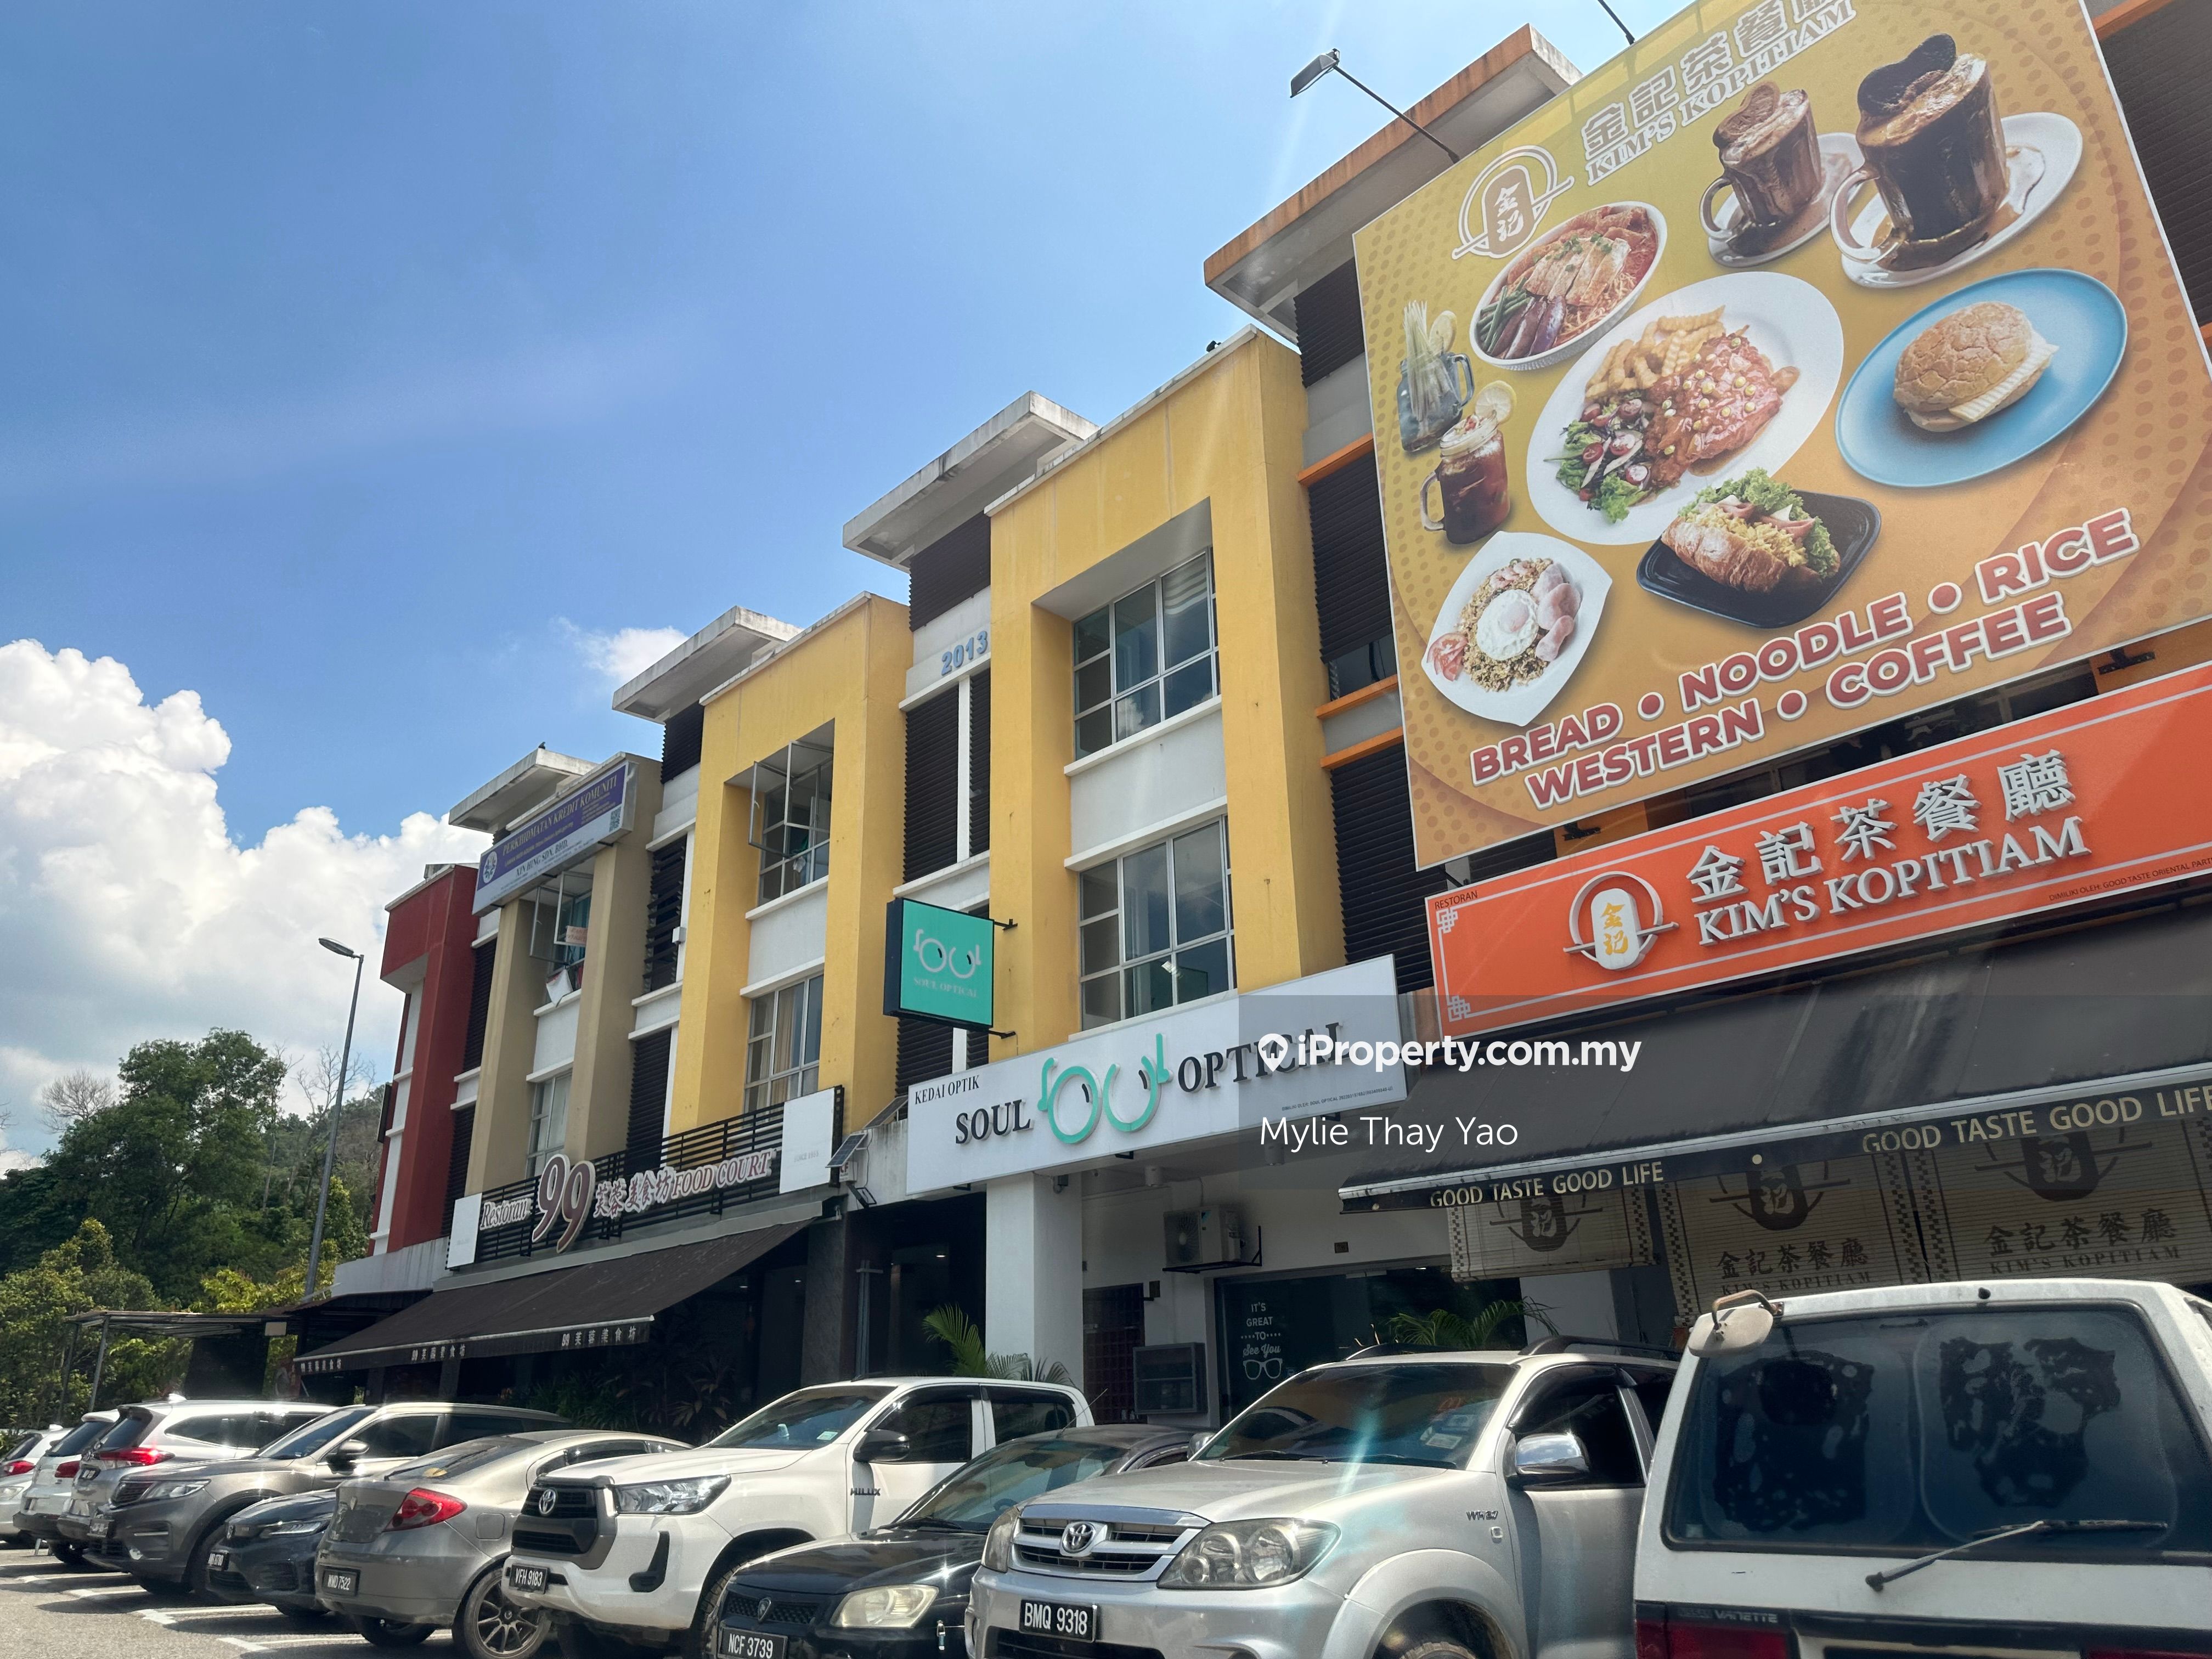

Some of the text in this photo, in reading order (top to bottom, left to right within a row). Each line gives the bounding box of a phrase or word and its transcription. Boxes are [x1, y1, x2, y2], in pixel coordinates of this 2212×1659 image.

[1587, 0, 1853, 183] KIM'S KOPITIAM
[941, 631, 988, 676] 2013
[1472, 509, 2138, 783] BREAD NOODLE RICE
[1527, 592, 2070, 808] WESTERN COFFEE
[1686, 749, 2075, 904] 金記茶餐廳
[1694, 815, 2091, 946] KIM'S KOPITIAM
[2049, 857, 2212, 901] DIMILIKI OLEH: GOOD TASTE ORIENTAL PART
[1435, 890, 1478, 910] RESTORAN
[915, 1075, 980, 1105] KEDAI OPTIK
[956, 1099, 1032, 1144] SOUL
[1178, 1022, 1351, 1093] OPTICAL
[1862, 1085, 2212, 1153] GOOD TASTE GOOD LIFE
[1430, 1161, 1664, 1207] GOOD TASTE GOOD LIFE
[480, 1200, 530, 1229] Restoran
[532, 1154, 596, 1254] 99
[672, 1166, 714, 1199] FOOD
[716, 1149, 773, 1188] COURT
[2062, 1245, 2181, 1268] KOPITIAM
[1778, 1271, 1871, 1290] KOPITIAM
[1246, 1317, 1273, 1327] GREAT
[1251, 1302, 1266, 1313] IT'S
[1243, 1344, 1282, 1358] See You
[850, 1487, 881, 1496] HILUX
[338, 1575, 351, 1590] 7522
[516, 1568, 543, 1587] VFH 9183
[1024, 1602, 1088, 1635] BMQ 9318
[728, 1633, 774, 1658] NCF 3739
